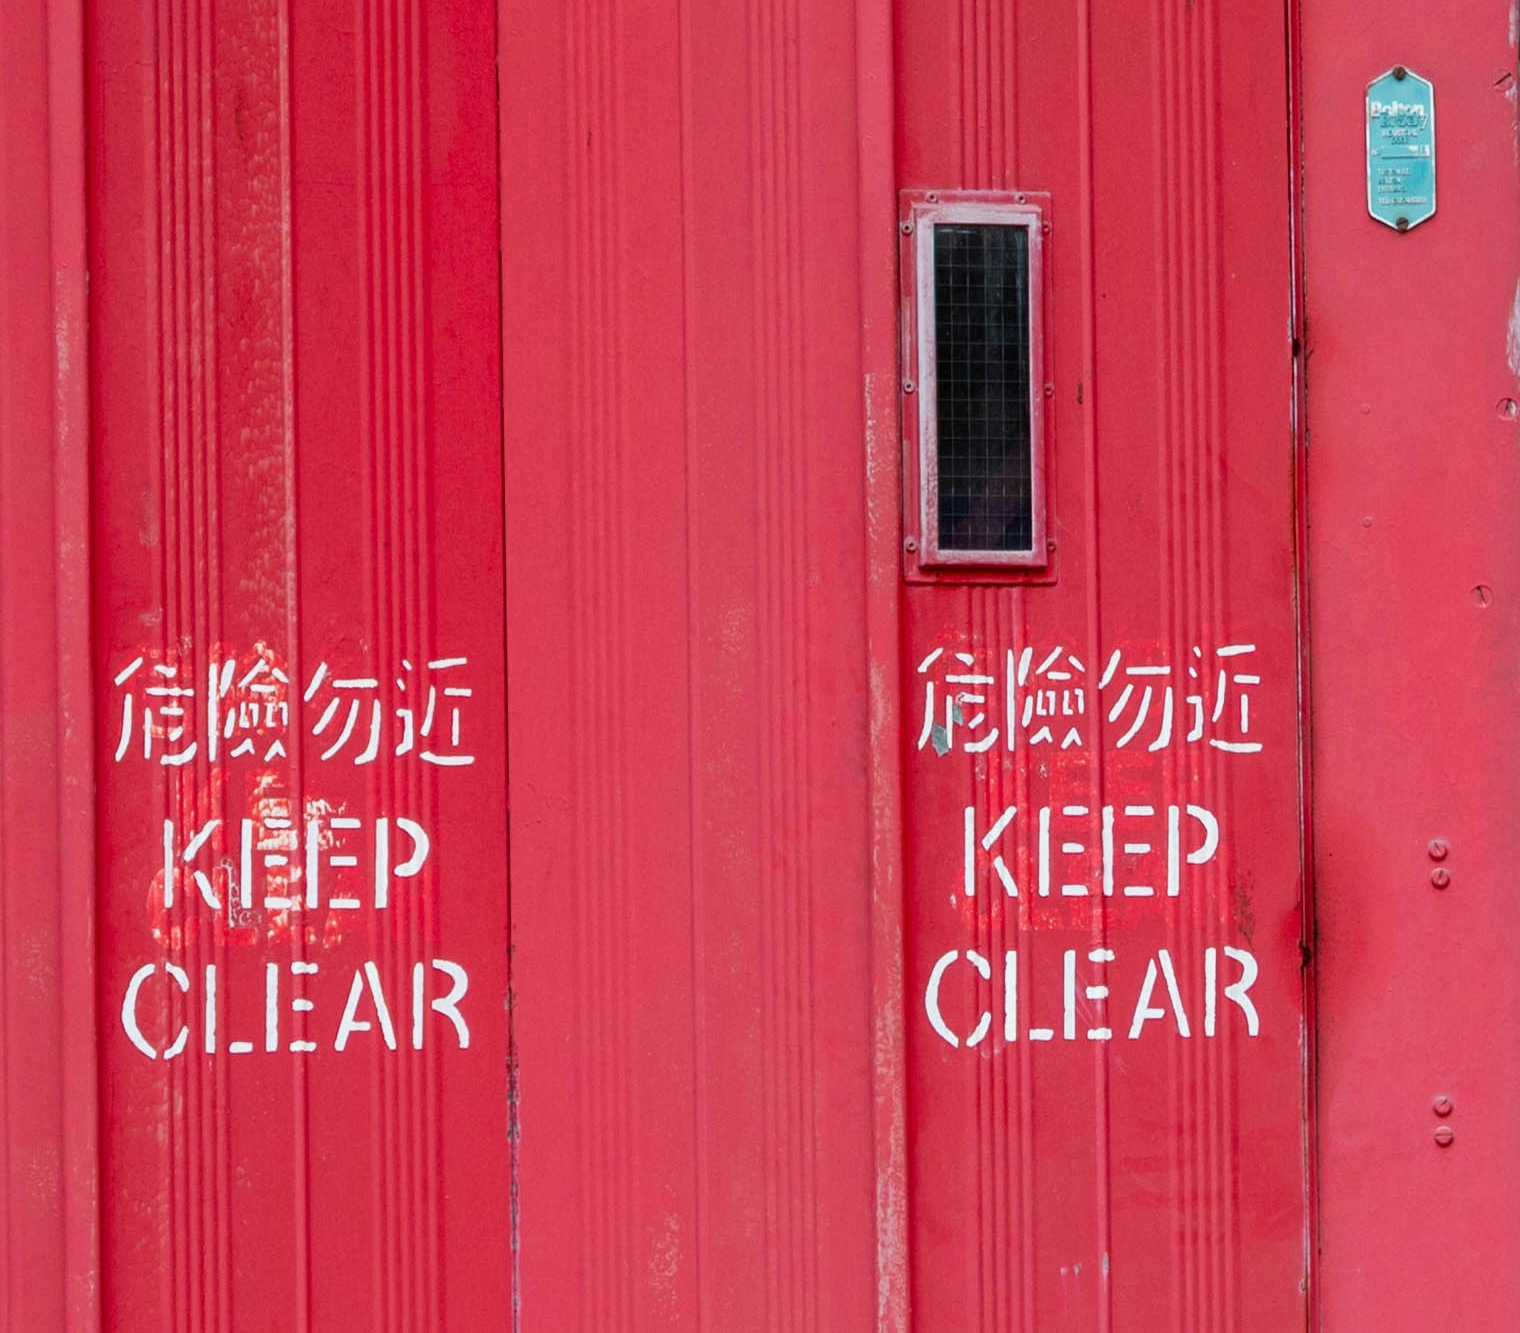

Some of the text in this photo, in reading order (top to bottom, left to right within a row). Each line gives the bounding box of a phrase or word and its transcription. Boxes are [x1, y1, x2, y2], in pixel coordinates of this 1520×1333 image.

[115, 657, 474, 766] 危險勿近
[918, 644, 1262, 756] 危險勿近
[164, 818, 430, 910] KEEP
[965, 804, 1219, 897] KEEP
[122, 959, 469, 1059] CLEAR
[925, 946, 1259, 1048] CLEAR
